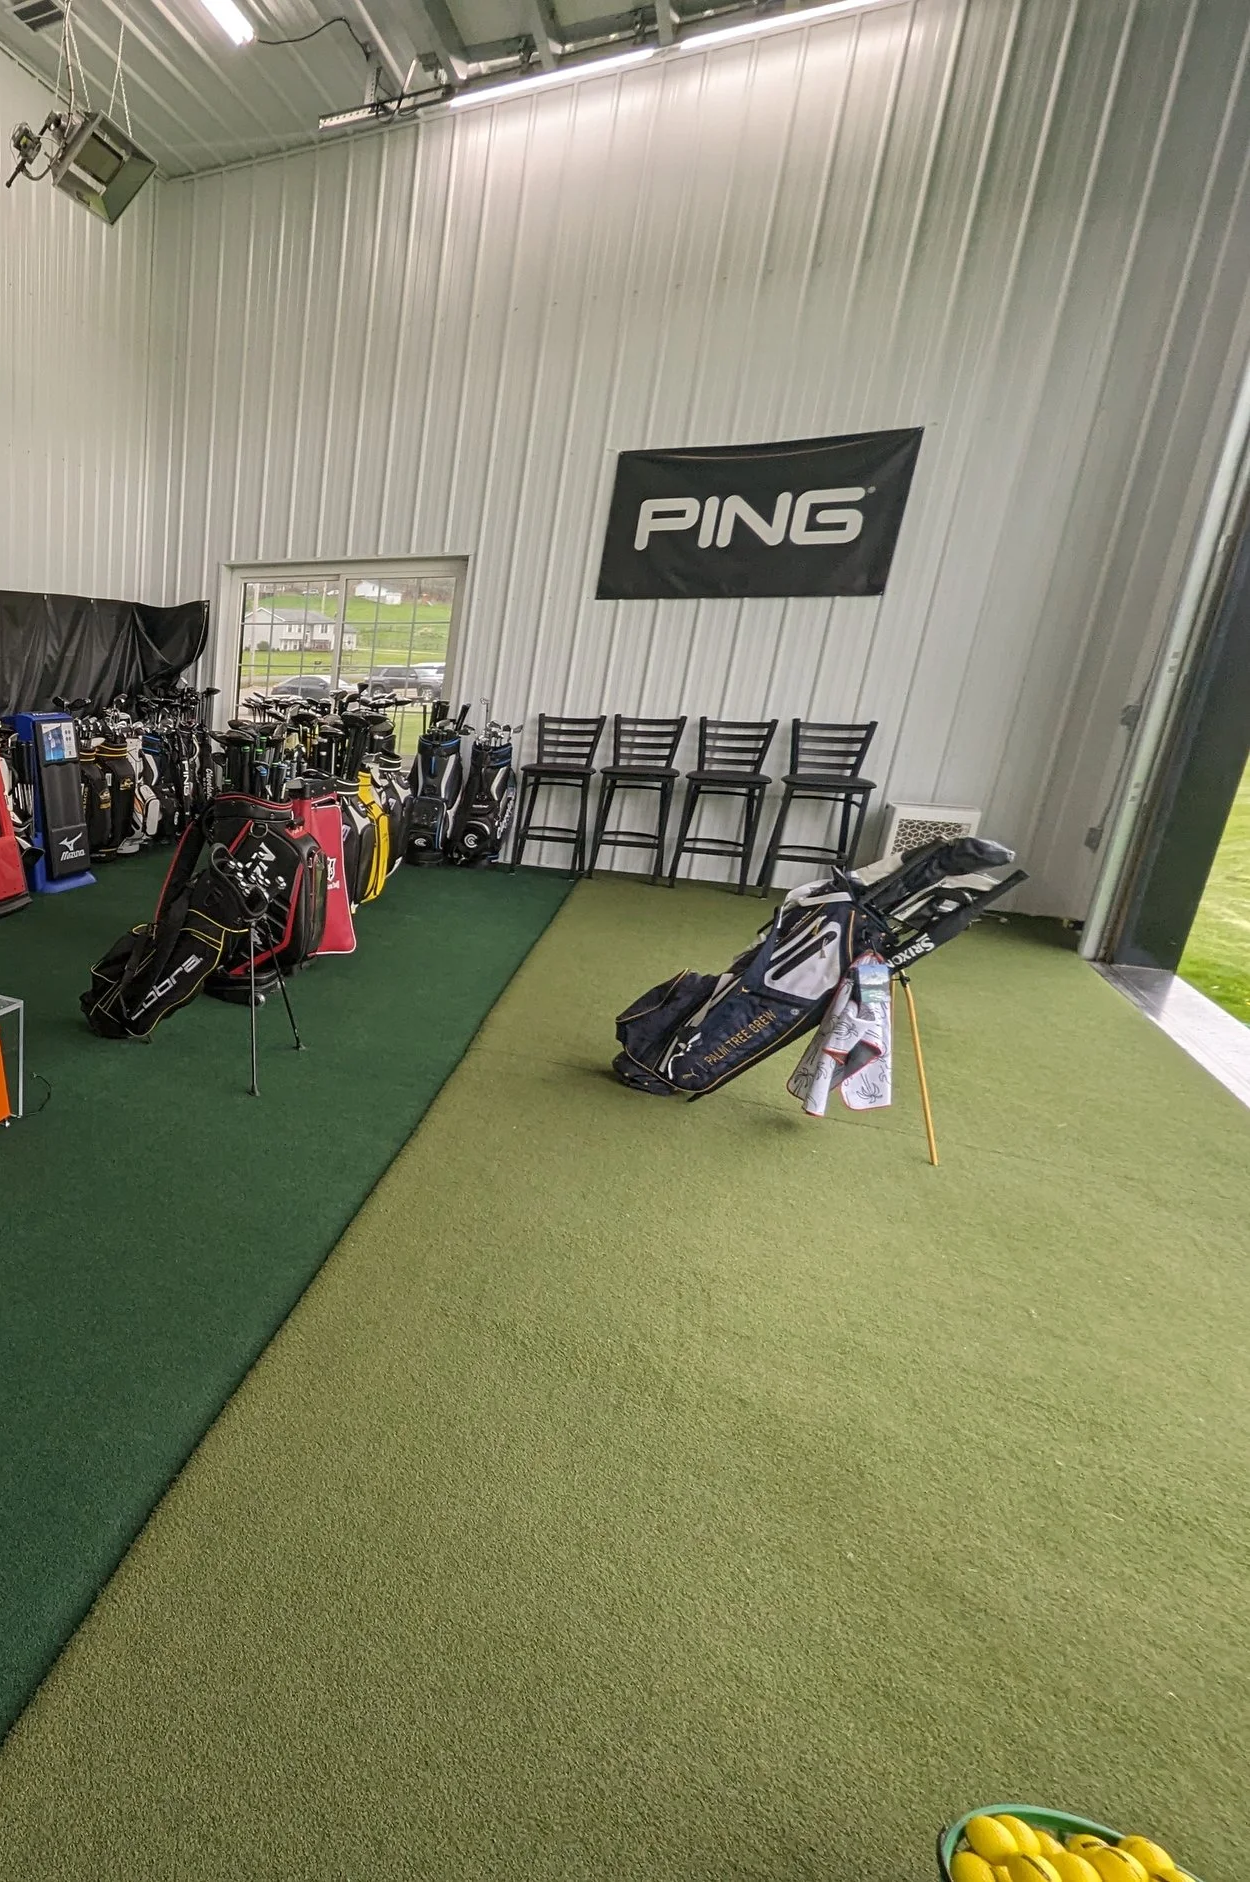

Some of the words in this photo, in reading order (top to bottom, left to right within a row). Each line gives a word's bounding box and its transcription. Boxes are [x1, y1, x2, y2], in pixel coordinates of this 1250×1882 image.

[634, 486, 864, 551] PING
[182, 760, 190, 796] PING
[704, 1045, 731, 1066] PALM
[725, 1029, 752, 1049] TREE
[748, 1009, 777, 1033] CREW
